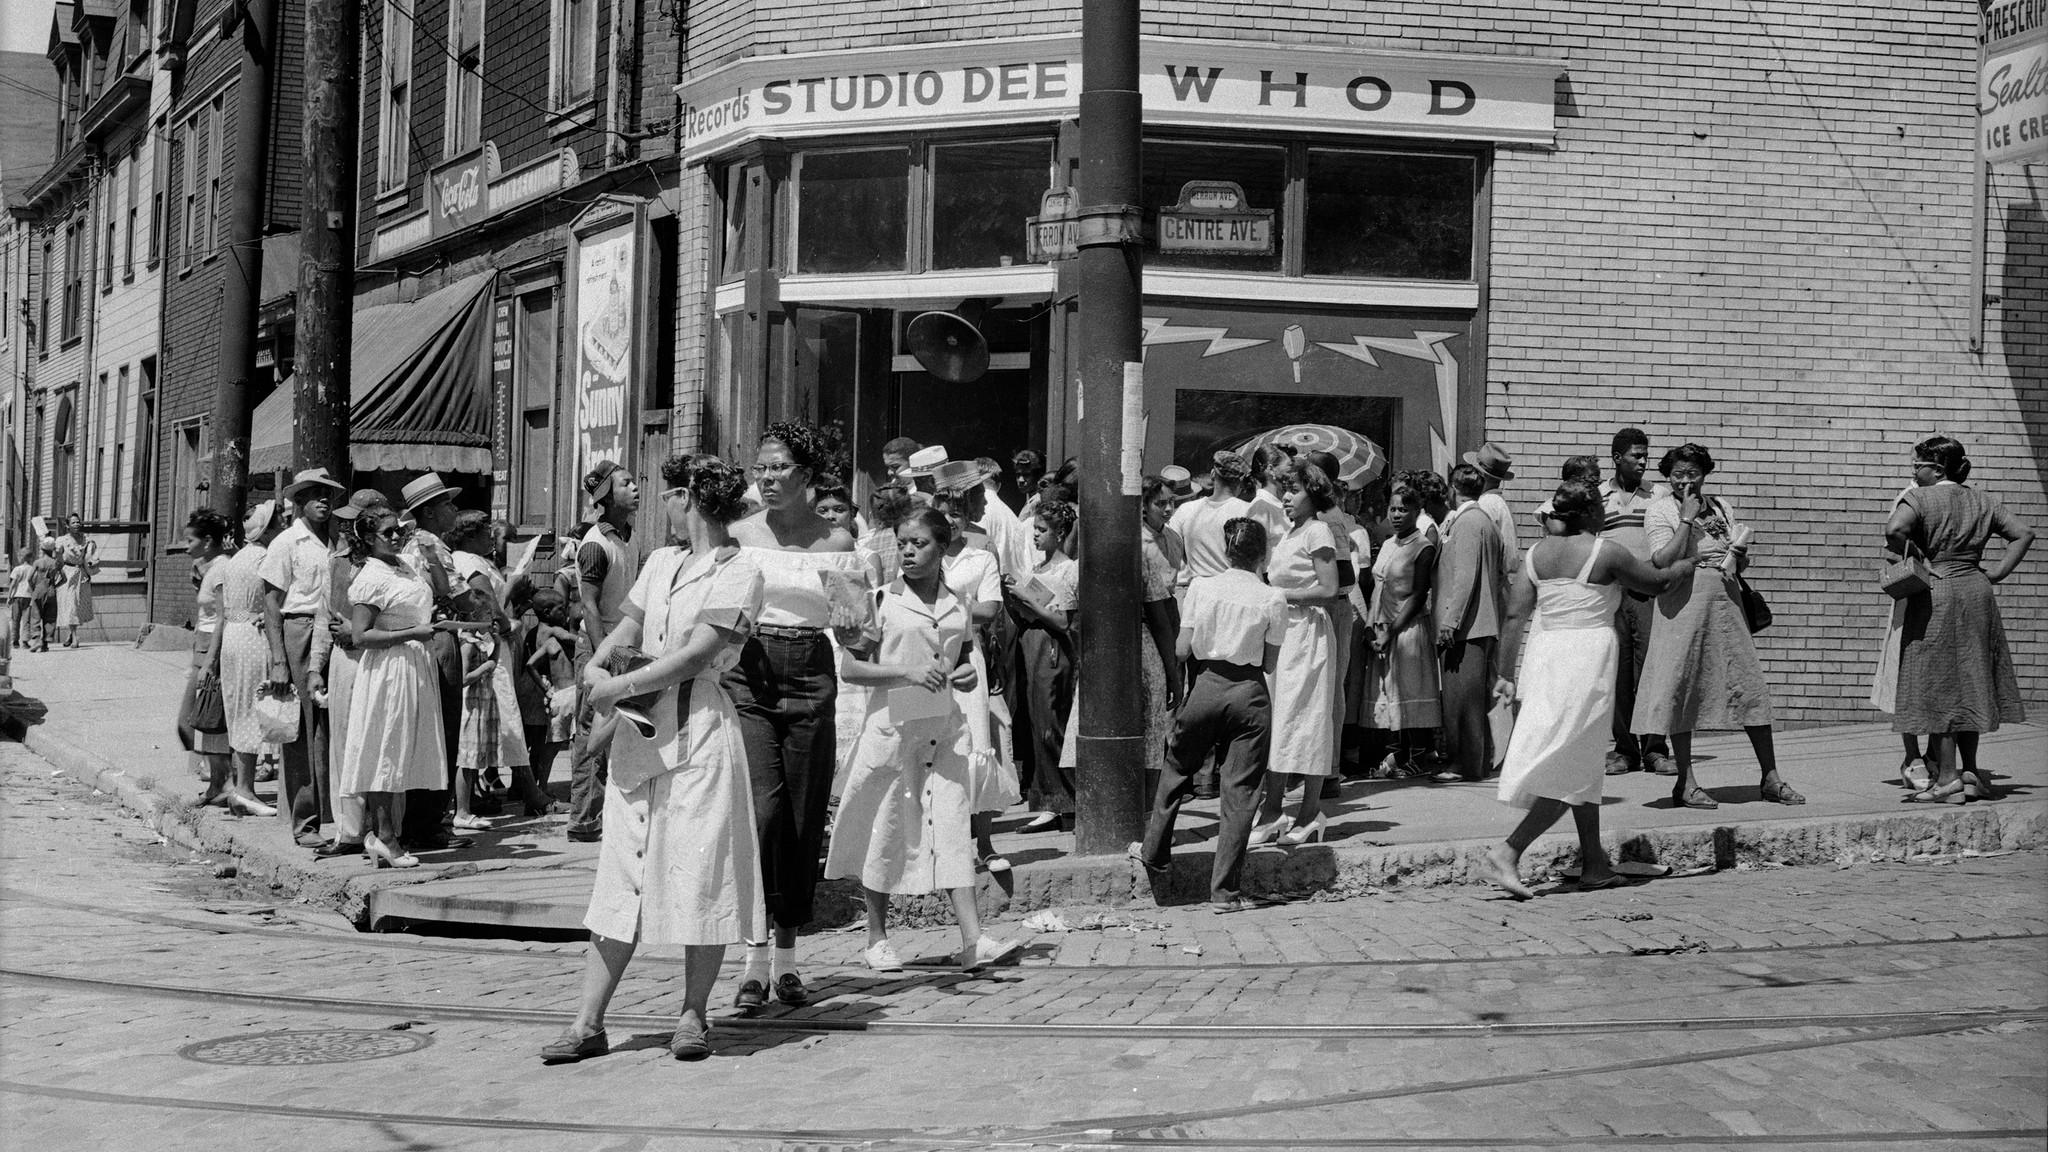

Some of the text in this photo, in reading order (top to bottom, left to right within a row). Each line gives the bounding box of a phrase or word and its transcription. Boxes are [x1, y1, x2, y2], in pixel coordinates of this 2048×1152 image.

[1986, 0, 2047, 43] PRESCRIP
[762, 69, 944, 116] STUDIO
[962, 60, 1068, 104] DEE
[688, 87, 750, 139] Records
[1987, 124, 2011, 150] ICE
[1165, 218, 1262, 242] CENTRE AVE.
[495, 320, 510, 337] MAIL
[494, 339, 513, 357] POUCH
[579, 370, 625, 435] Sunny
